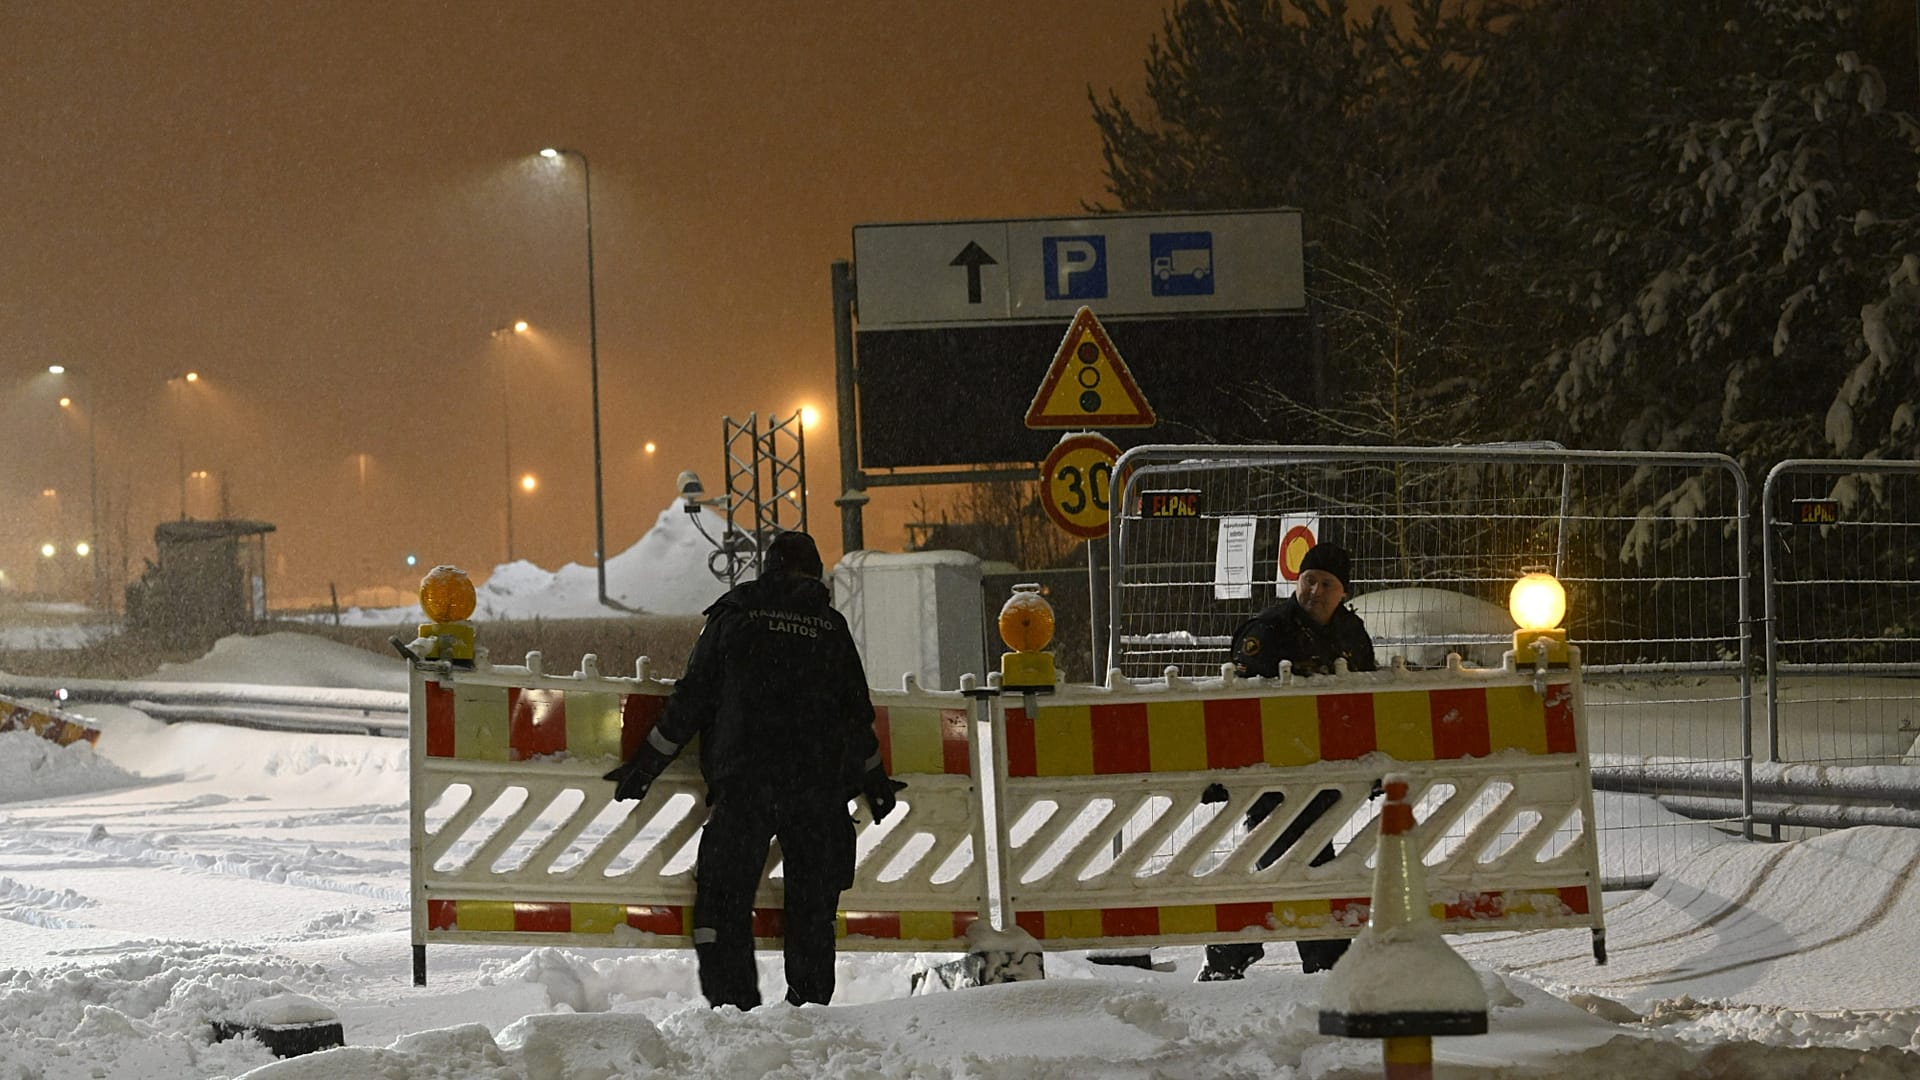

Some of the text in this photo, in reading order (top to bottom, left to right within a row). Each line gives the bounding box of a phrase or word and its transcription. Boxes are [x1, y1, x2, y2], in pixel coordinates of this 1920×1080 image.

[1056, 241, 1096, 295] P
[1058, 462, 1112, 515] 30
[1152, 495, 1197, 516] ELPAC
[768, 620, 817, 638] LAITOS
